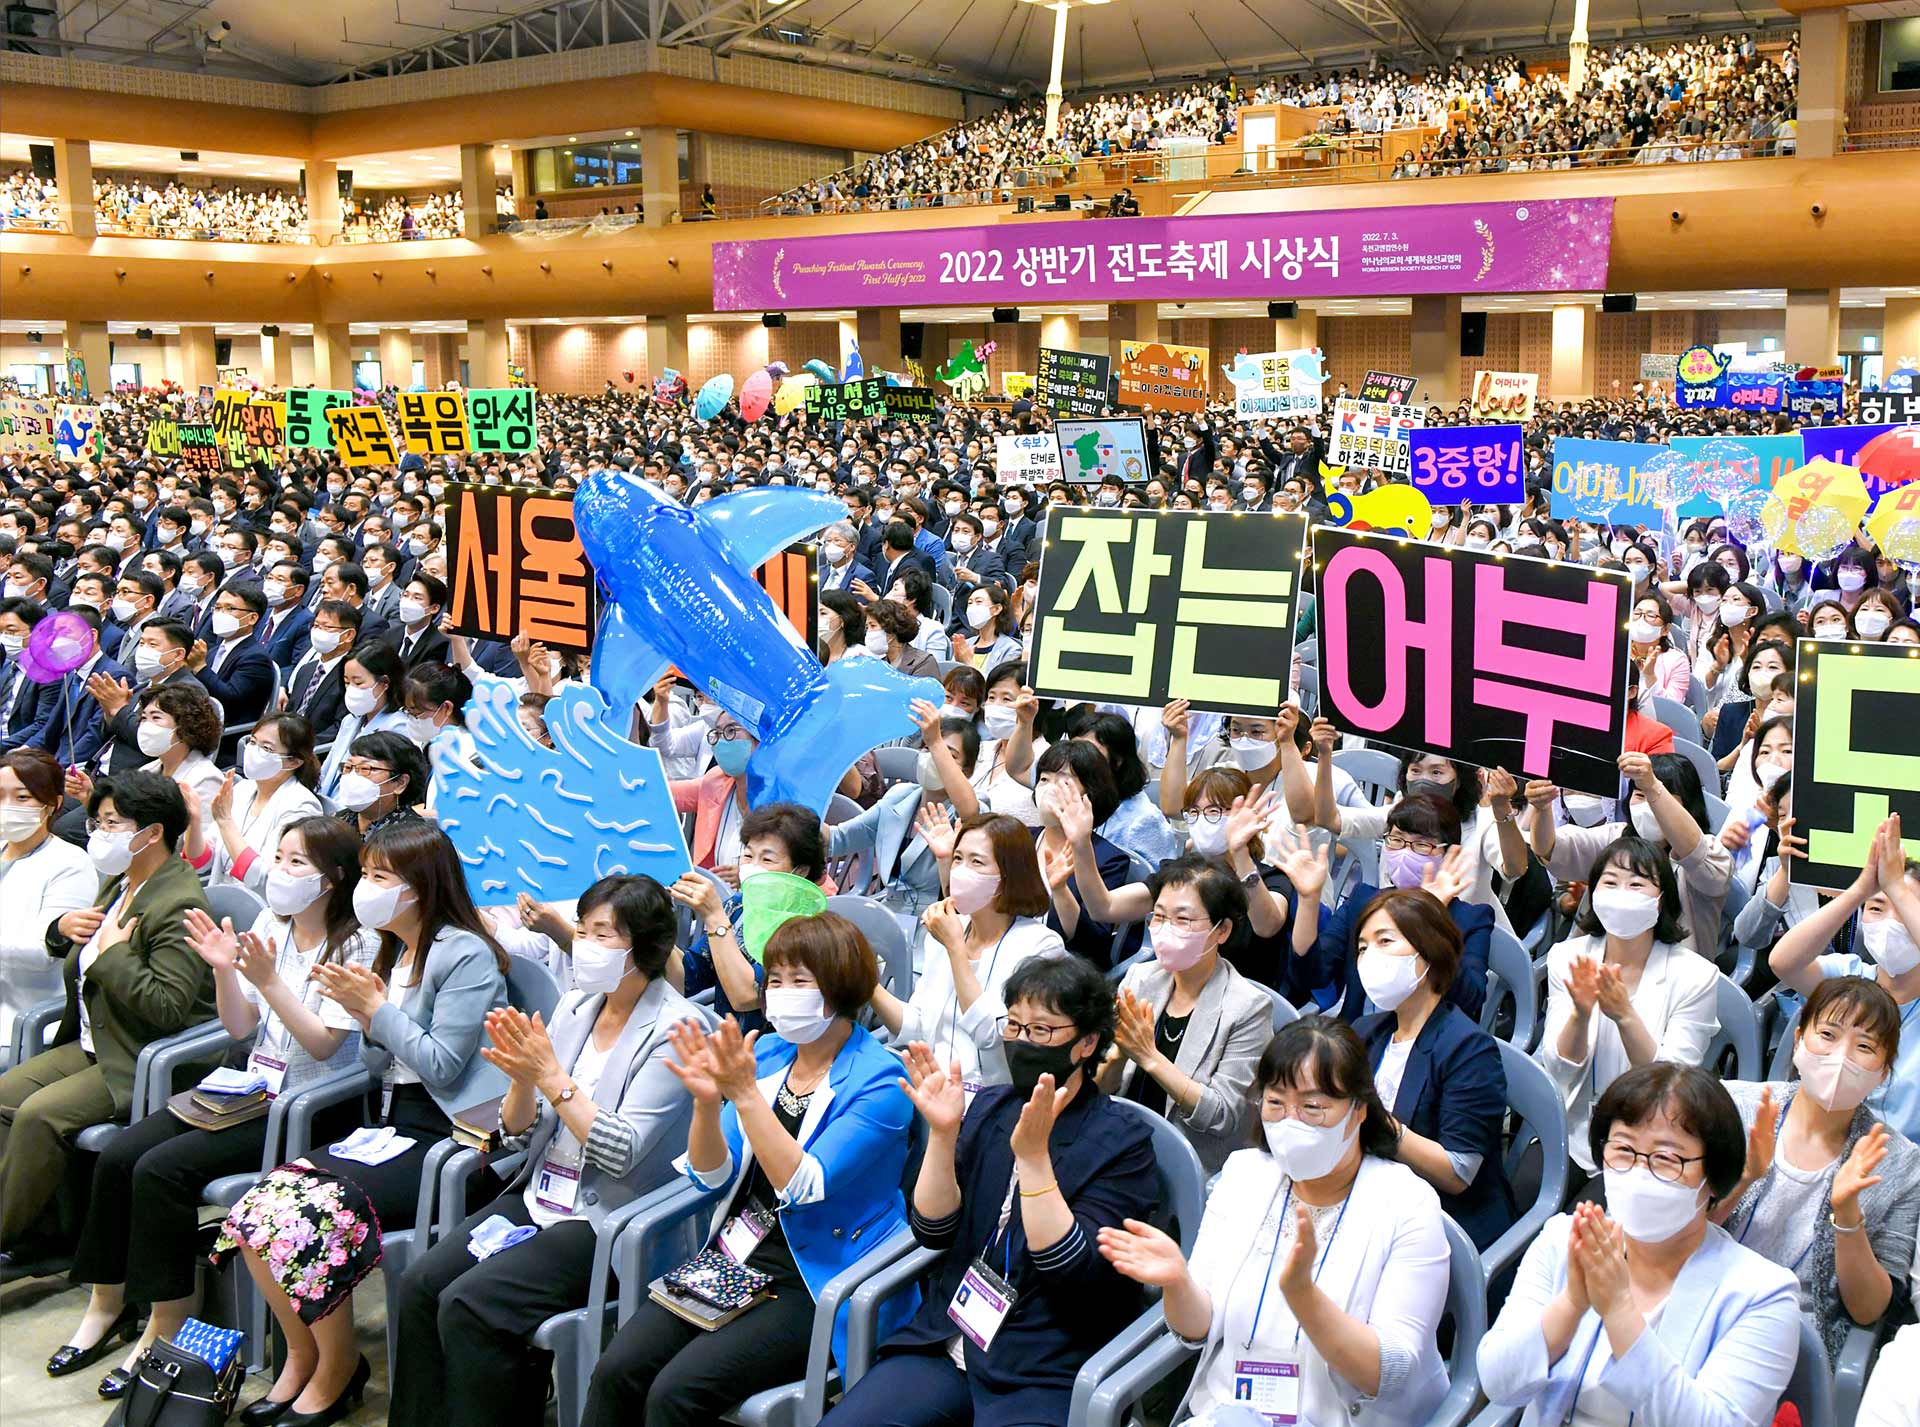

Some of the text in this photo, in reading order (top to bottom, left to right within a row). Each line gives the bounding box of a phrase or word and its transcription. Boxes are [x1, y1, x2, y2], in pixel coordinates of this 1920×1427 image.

[1362, 233, 1381, 241] 2022.
[827, 261, 856, 273] Festival
[856, 260, 886, 272] Awards
[939, 236, 1339, 287] 2022 상반기 전도축제 시상식
[909, 275, 926, 283] 2022
[1262, 358, 1290, 375] 전주
[952, 364, 990, 401] 대어
[1153, 384, 1203, 399] 하겠습니다
[1262, 376, 1291, 393] 덕진
[1495, 378, 1521, 388] 어머니
[820, 404, 848, 421] 시온
[884, 393, 936, 411] 어머니
[1239, 394, 1319, 414] 이게머선129
[241, 405, 276, 447] 완성
[404, 395, 465, 453] 복음
[472, 391, 534, 450] 완성
[178, 426, 216, 446] 어머니와
[332, 411, 396, 463] 천국
[1338, 434, 1410, 457] 전주덕진이
[182, 446, 220, 469] 천국복음
[1030, 452, 1057, 465] 단비로
[1337, 450, 1410, 472] 하겠습니다
[1414, 441, 1520, 488] 3중랑!
[1019, 468, 1045, 481] 폭발적
[451, 491, 587, 648] 서울
[1036, 517, 1292, 708] 잡는
[1323, 545, 1619, 778] 어부
